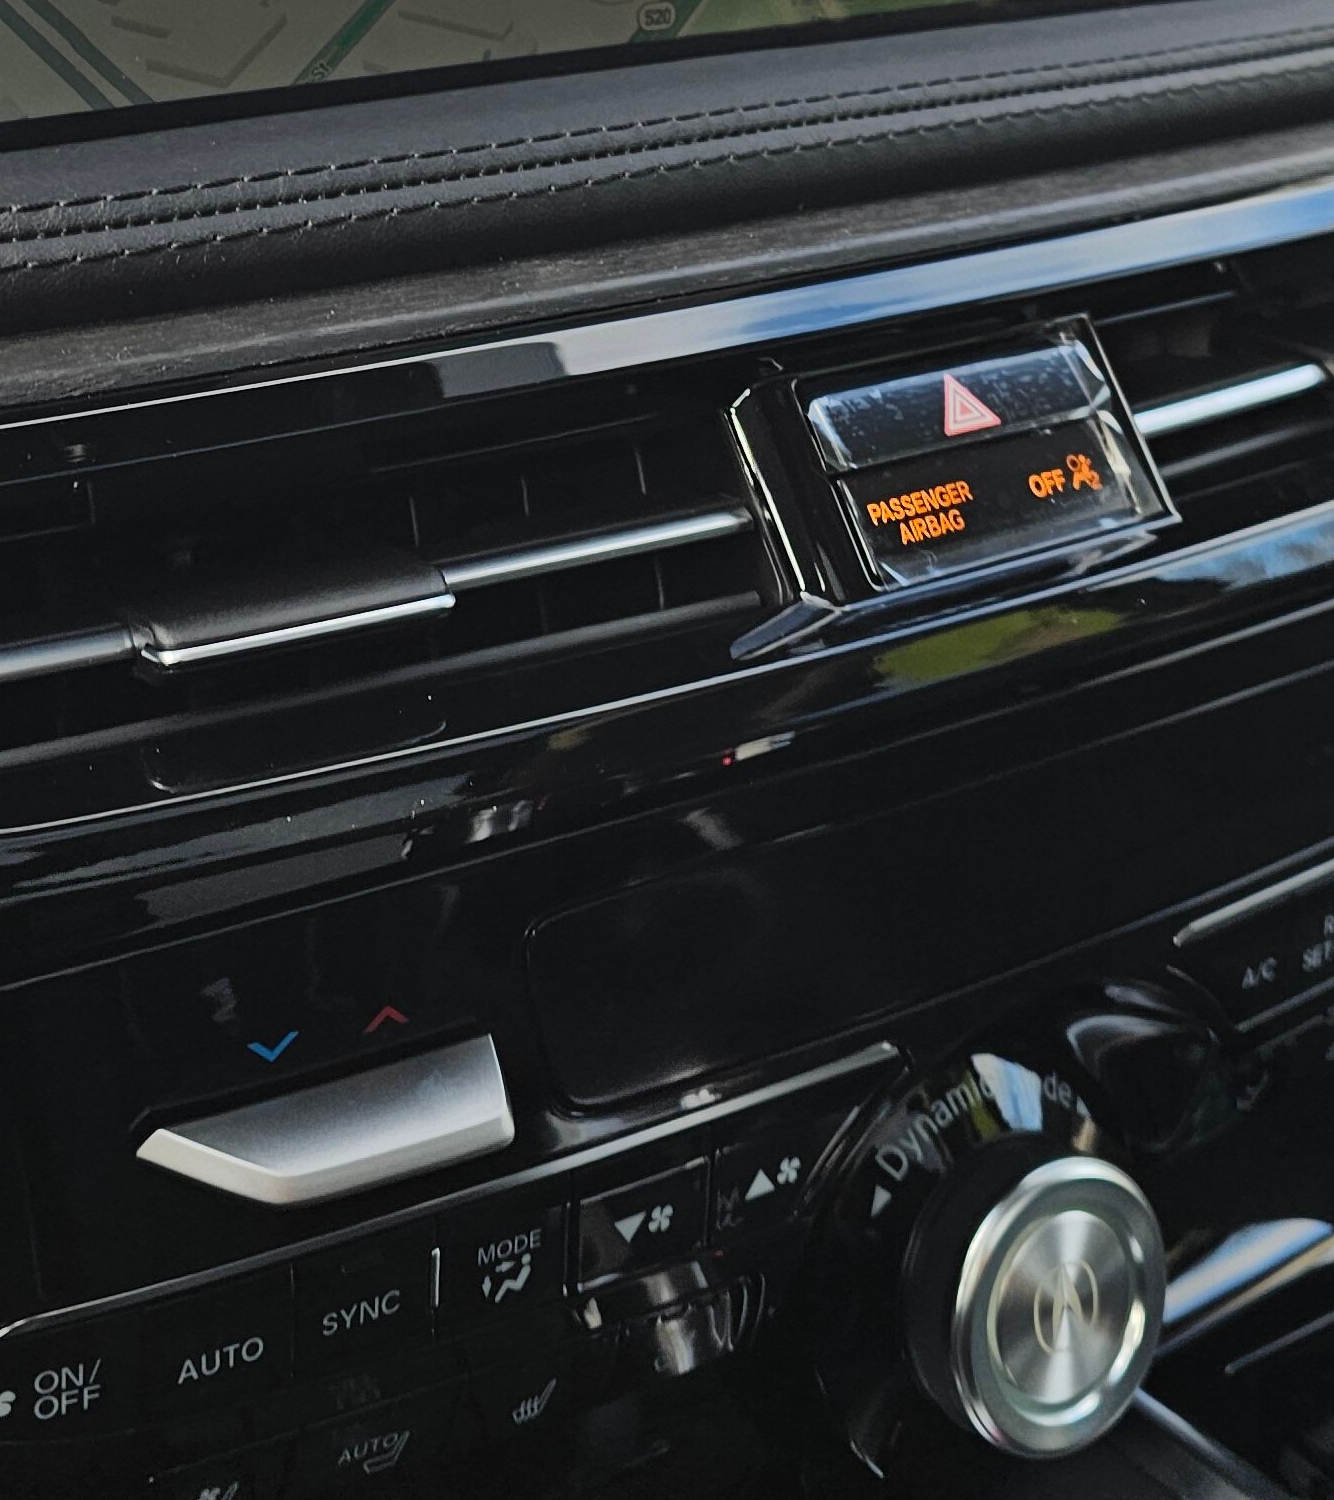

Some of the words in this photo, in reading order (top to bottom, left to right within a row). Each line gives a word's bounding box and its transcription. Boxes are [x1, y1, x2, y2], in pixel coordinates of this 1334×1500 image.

[644, 8, 672, 27] 520
[1028, 468, 1066, 499] OFF
[867, 480, 974, 527] PASSENGER
[898, 509, 966, 545] AIRBAG
[1241, 956, 1278, 989] A/C
[476, 1228, 543, 1267] MODE
[321, 1288, 402, 1336] SYNC
[32, 1357, 103, 1392] ON/
[176, 1336, 265, 1385] AUTO
[32, 1382, 101, 1421] OFF
[337, 1431, 399, 1468] AUTO
